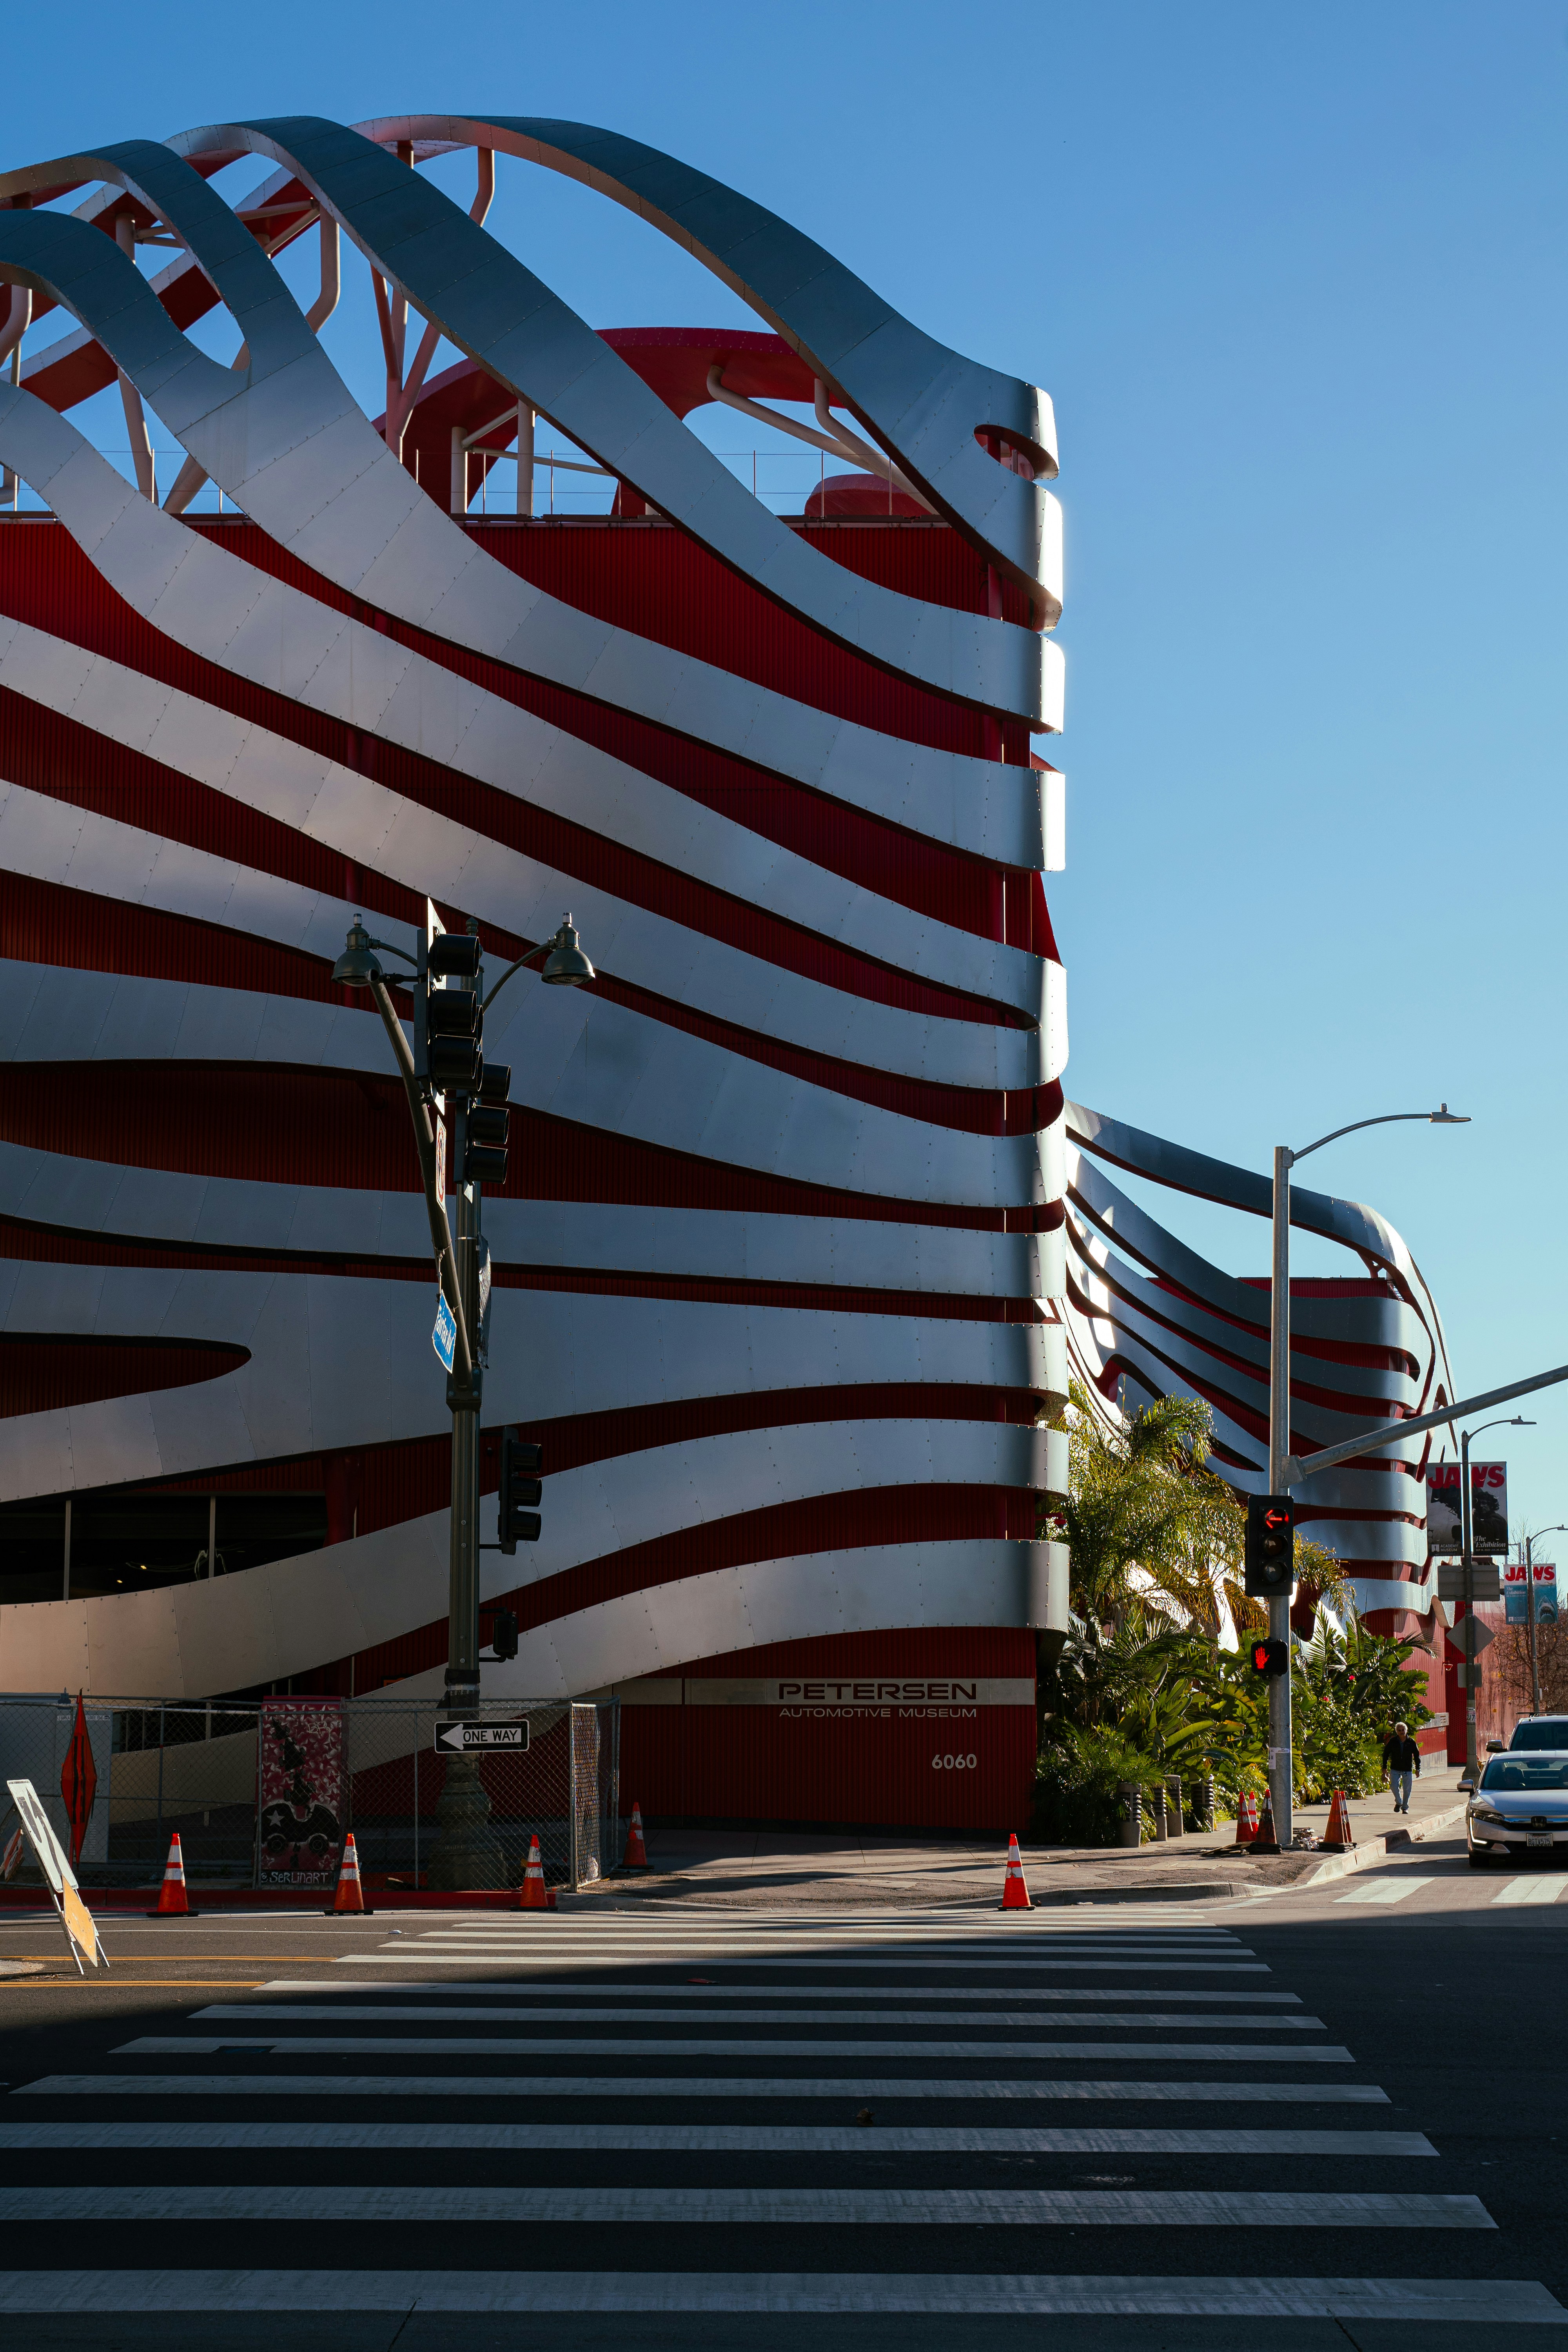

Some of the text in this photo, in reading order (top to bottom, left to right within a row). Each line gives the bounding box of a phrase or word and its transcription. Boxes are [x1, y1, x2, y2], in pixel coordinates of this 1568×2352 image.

[436, 1305, 455, 1355] Fairfax Av
[1427, 1465, 1505, 1489] JAWS
[1505, 1566, 1555, 1581] JAWS
[779, 1683, 976, 1700] PETERSEN
[779, 1708, 976, 1717] AUTOMOTIVE MUSEUM
[463, 1730, 518, 1742] ONE WAY
[932, 1754, 977, 1769] 6060
